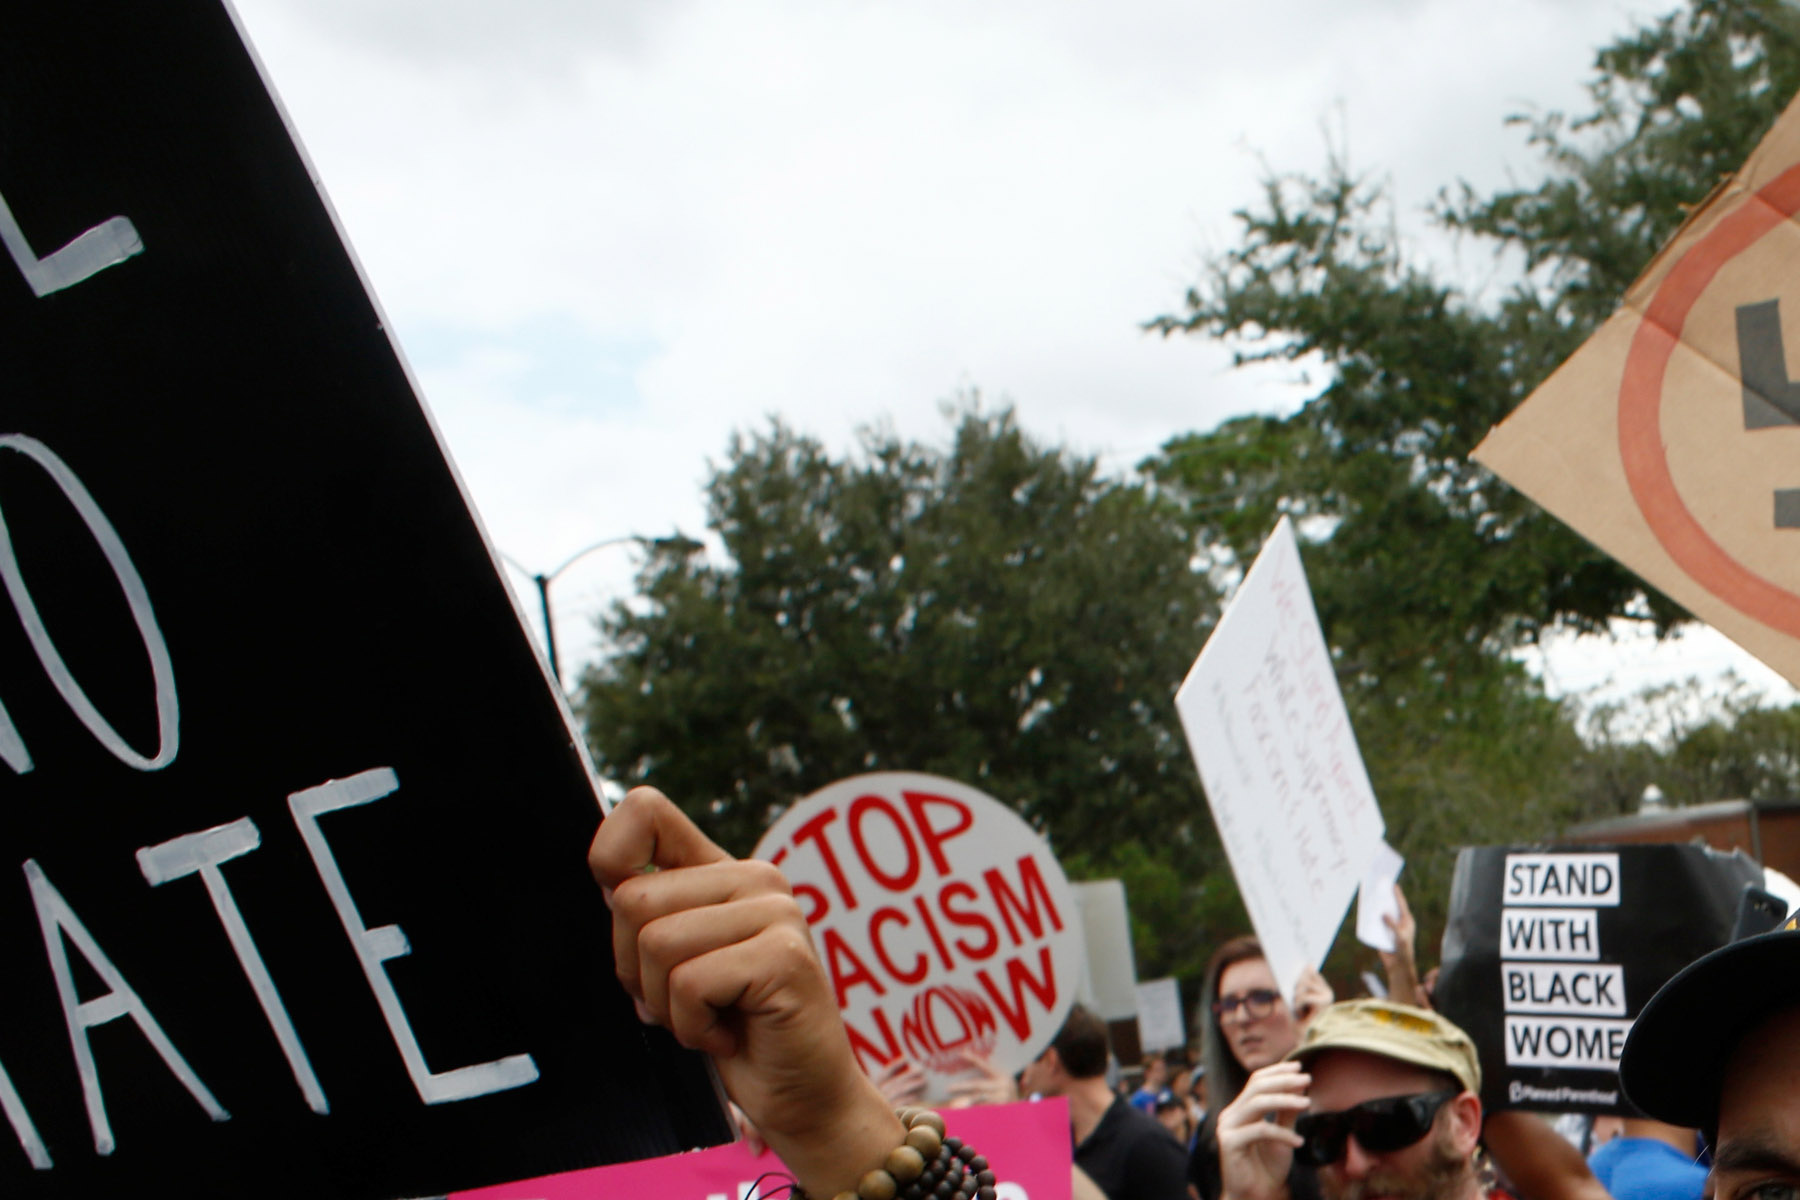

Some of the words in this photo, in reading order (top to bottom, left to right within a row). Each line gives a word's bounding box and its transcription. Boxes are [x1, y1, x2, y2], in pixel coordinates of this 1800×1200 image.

[0, 433, 180, 774] O
[1510, 863, 1613, 897] STAND
[823, 855, 1065, 1010] ACISM
[1507, 918, 1594, 953] WITH
[0, 766, 538, 1170] ATE
[1508, 971, 1616, 1006] BLACK
[1511, 1024, 1625, 1060] WOME
